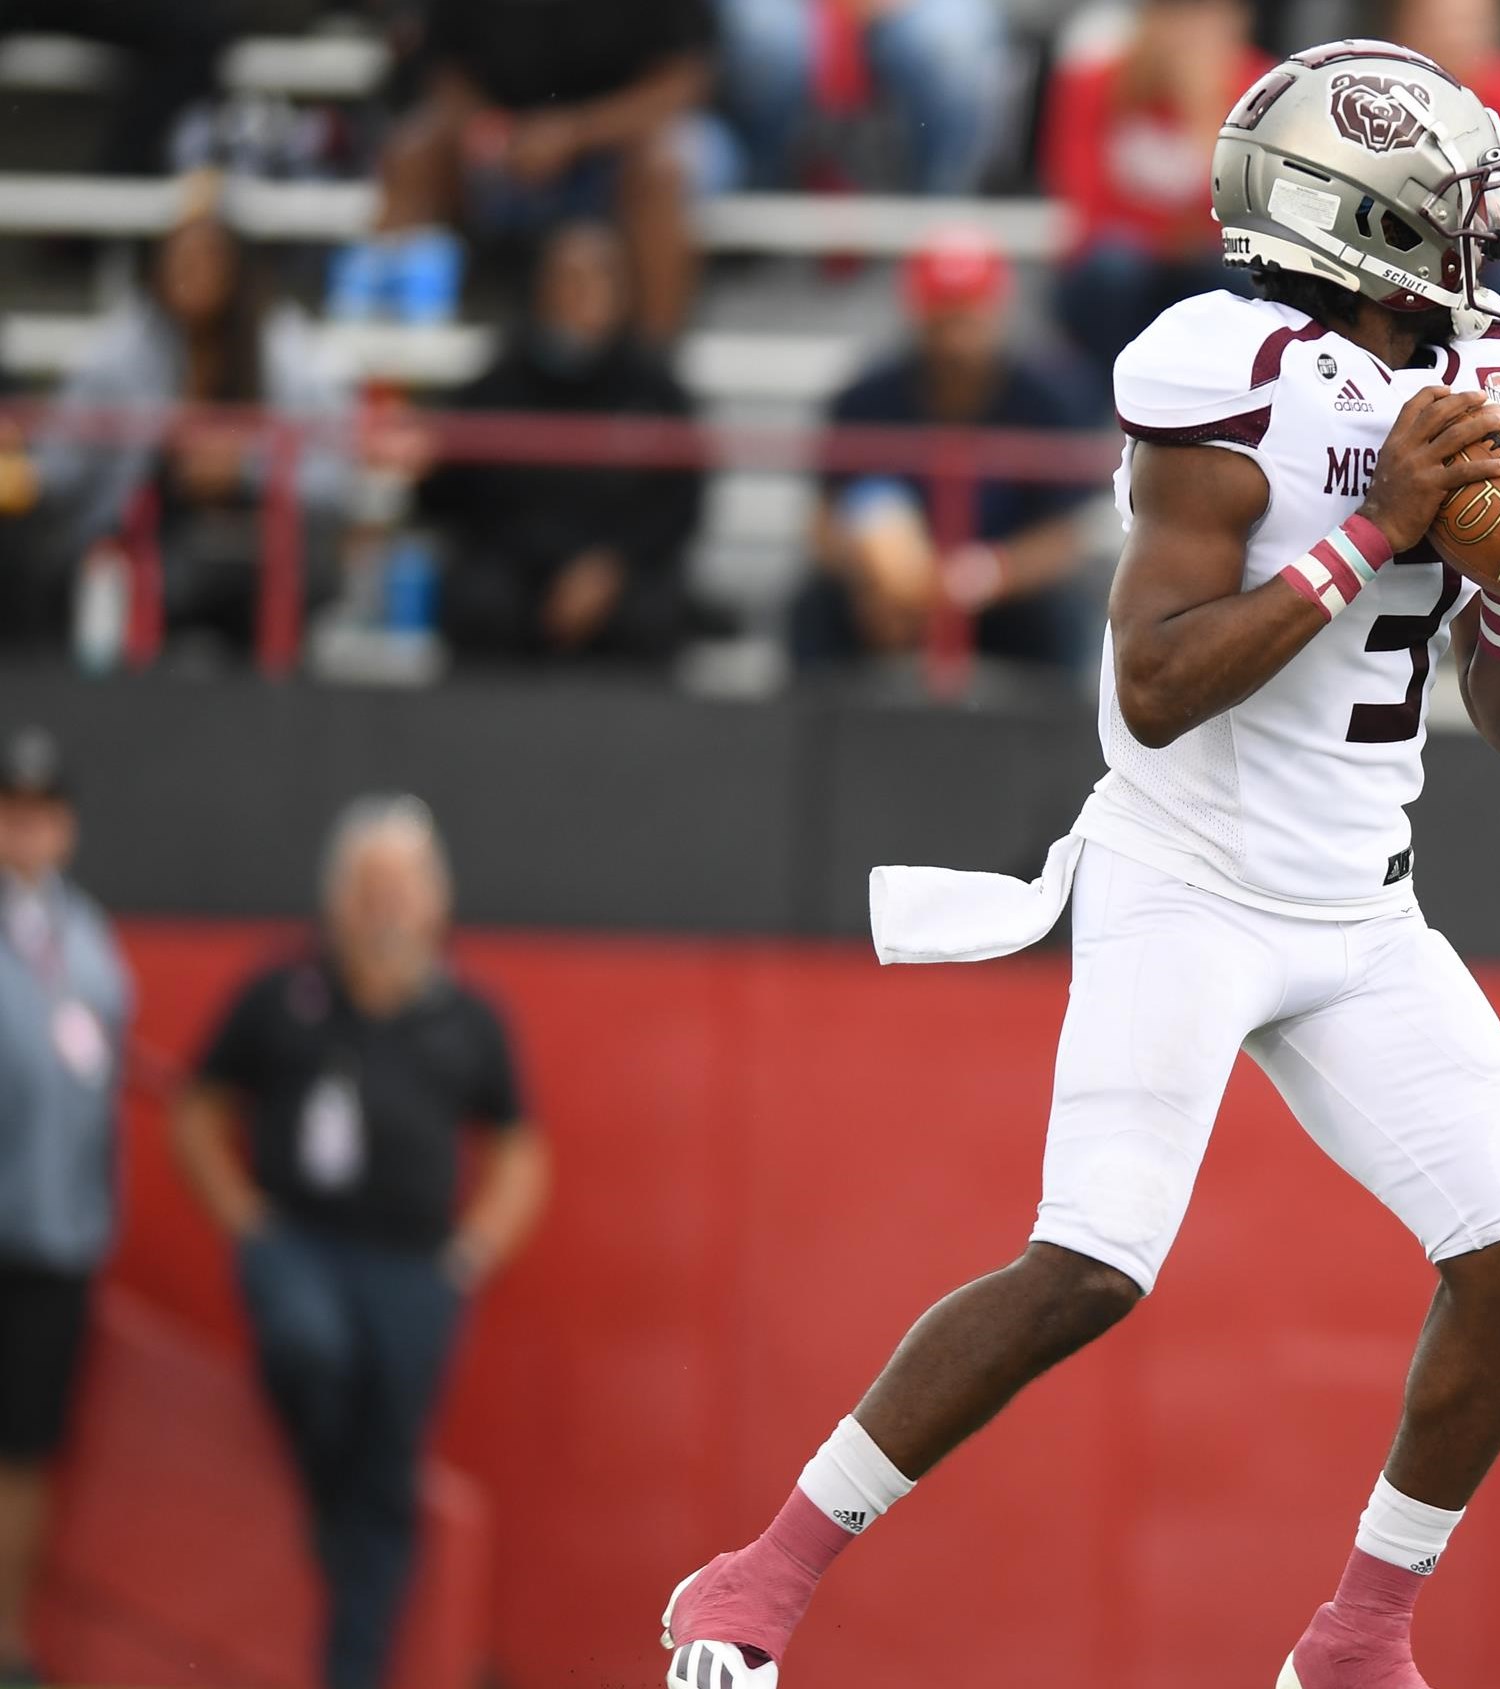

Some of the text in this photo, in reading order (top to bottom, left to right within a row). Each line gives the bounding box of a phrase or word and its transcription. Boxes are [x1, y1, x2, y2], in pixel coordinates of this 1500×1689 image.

[1382, 269, 1428, 293] schutt
[1334, 399, 1374, 412] adidas
[1324, 447, 1381, 496] MIS
[1345, 533, 1462, 743] 3
